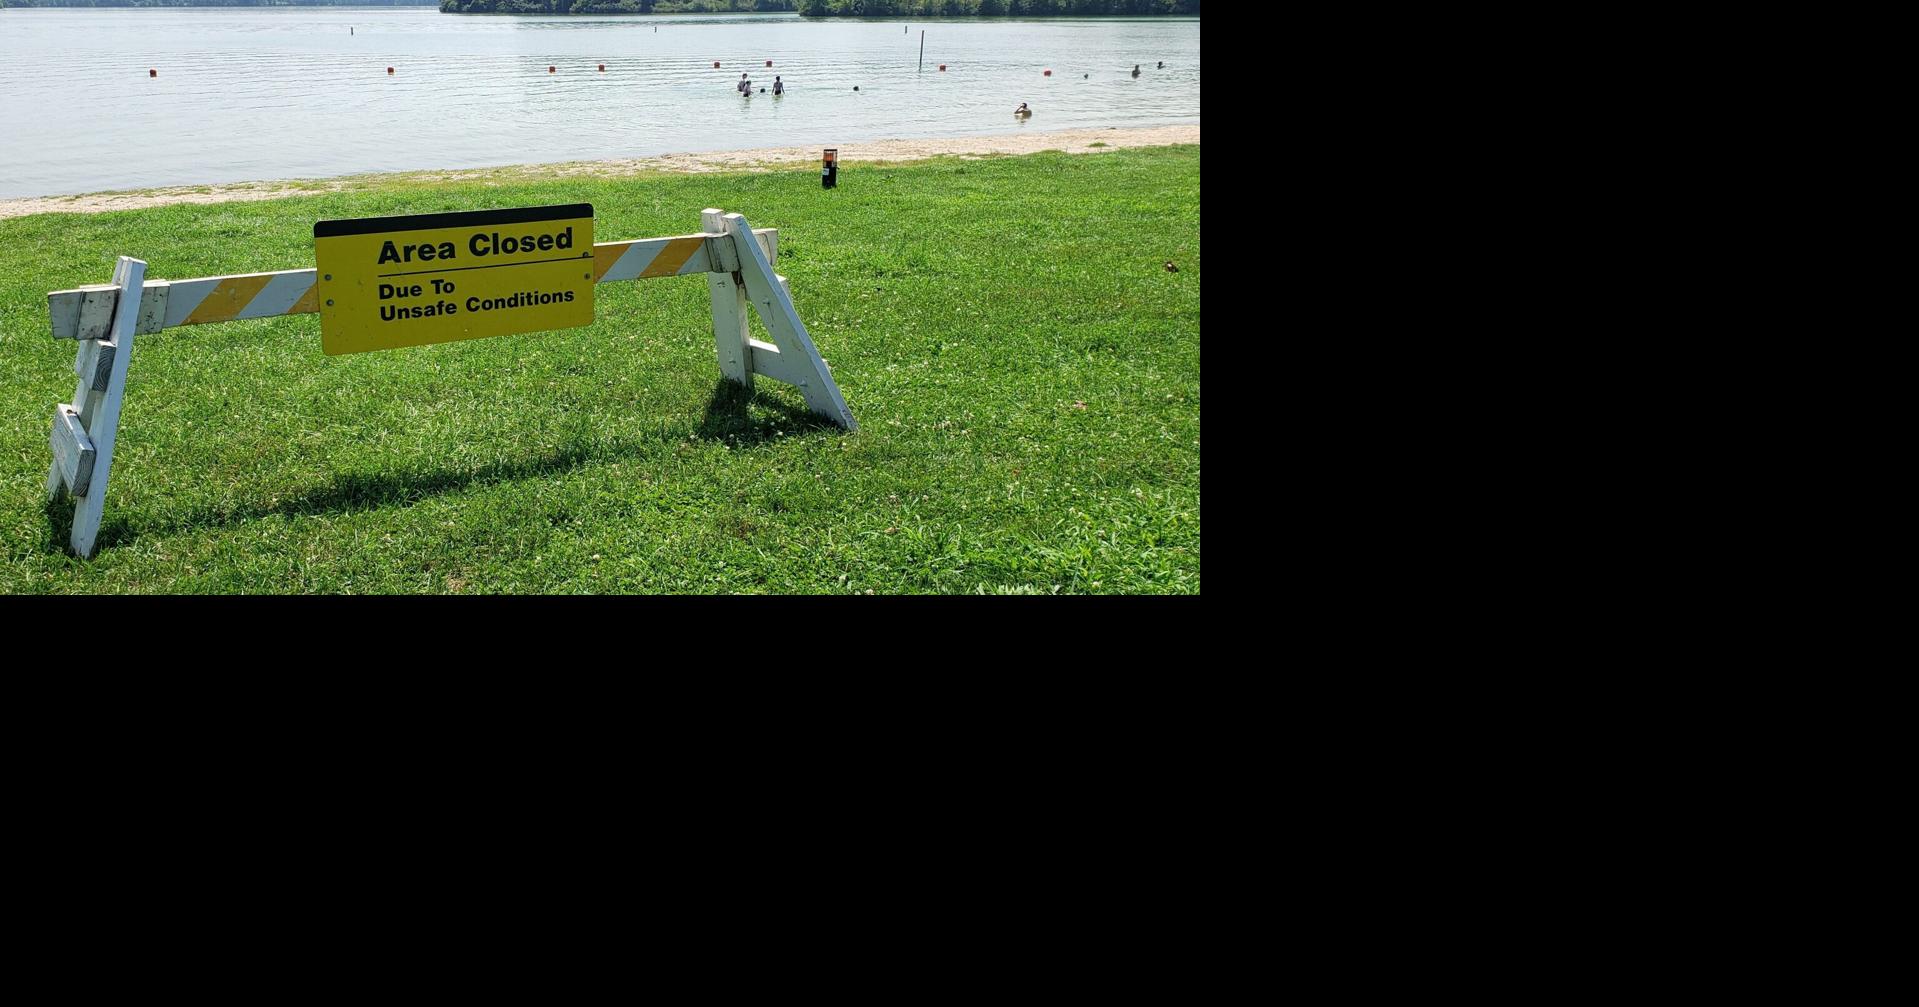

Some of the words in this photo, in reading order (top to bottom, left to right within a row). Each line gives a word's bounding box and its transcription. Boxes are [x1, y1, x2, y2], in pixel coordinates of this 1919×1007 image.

[377, 240, 456, 265] Area
[468, 226, 573, 257] Closed
[378, 283, 422, 300] Due
[430, 279, 455, 295] To
[379, 301, 457, 321] Unsafe
[466, 290, 575, 312] Conditions
